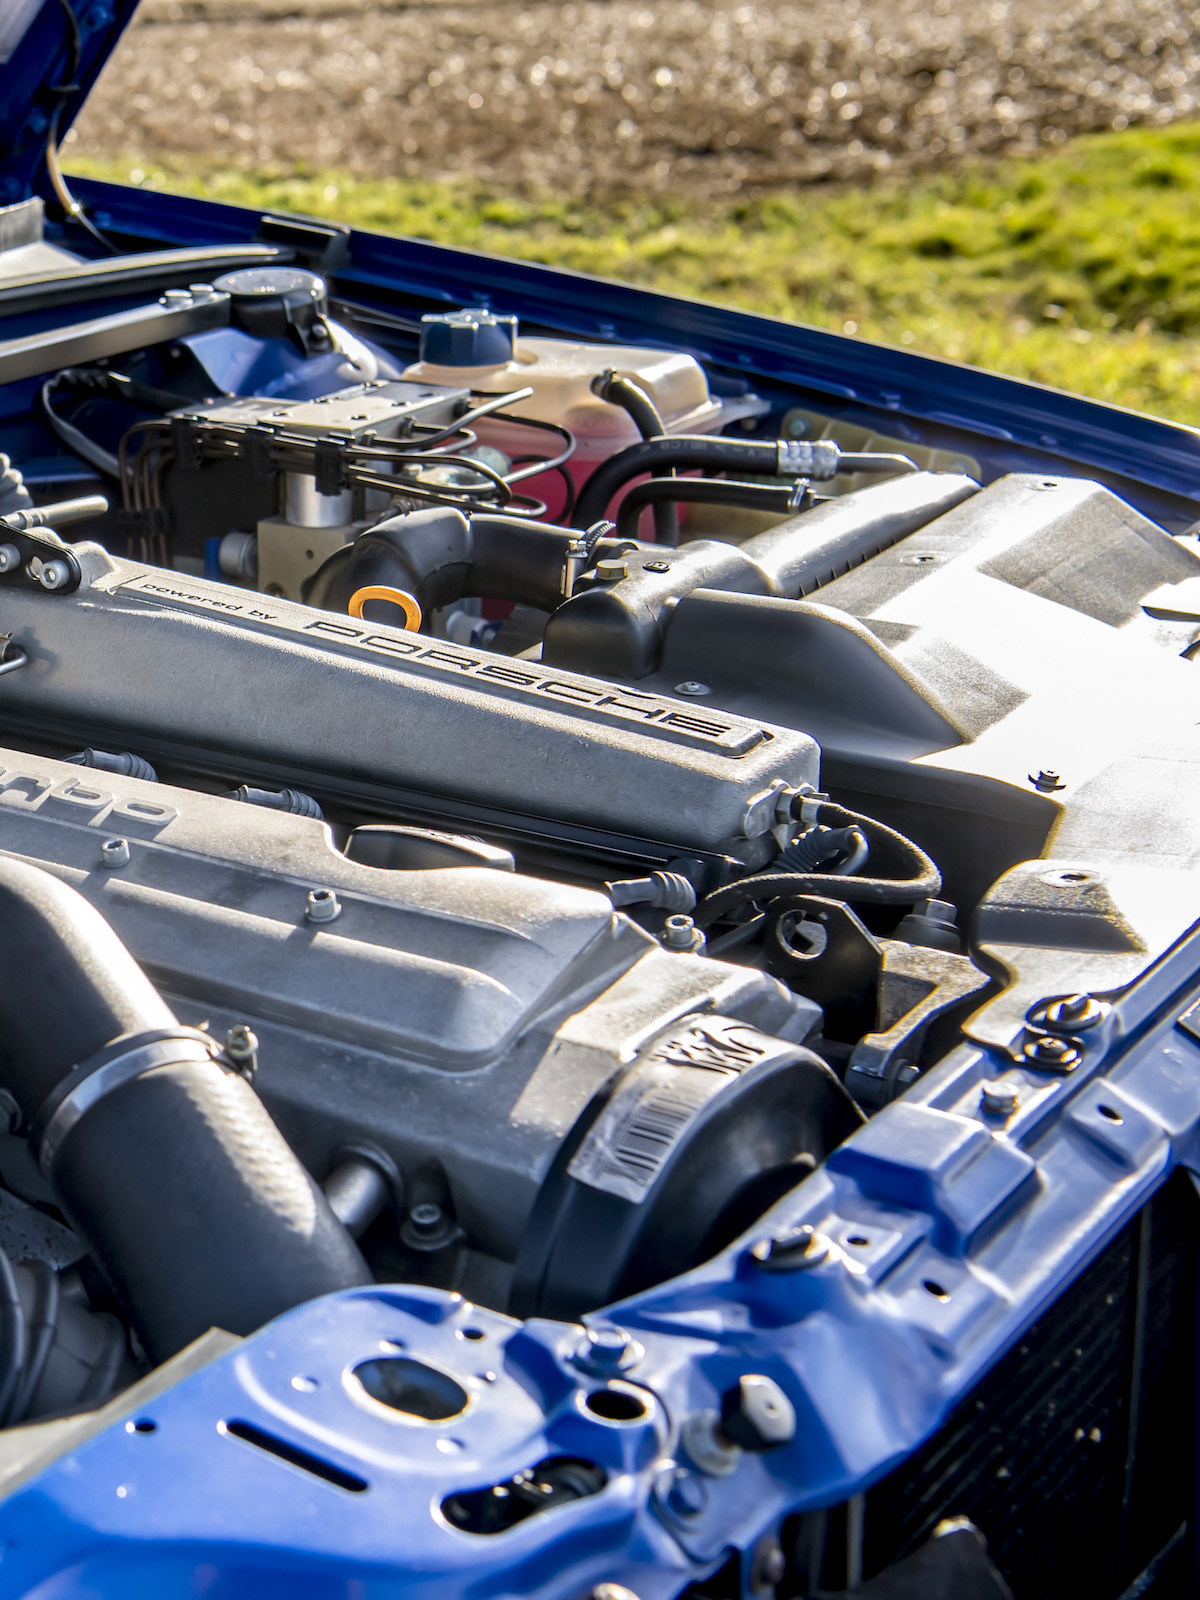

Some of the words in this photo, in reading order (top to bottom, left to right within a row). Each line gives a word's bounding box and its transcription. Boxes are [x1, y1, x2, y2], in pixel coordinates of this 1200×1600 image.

[141, 583, 243, 611] powered
[248, 609, 277, 620] by
[303, 621, 731, 738] PORSCHE
